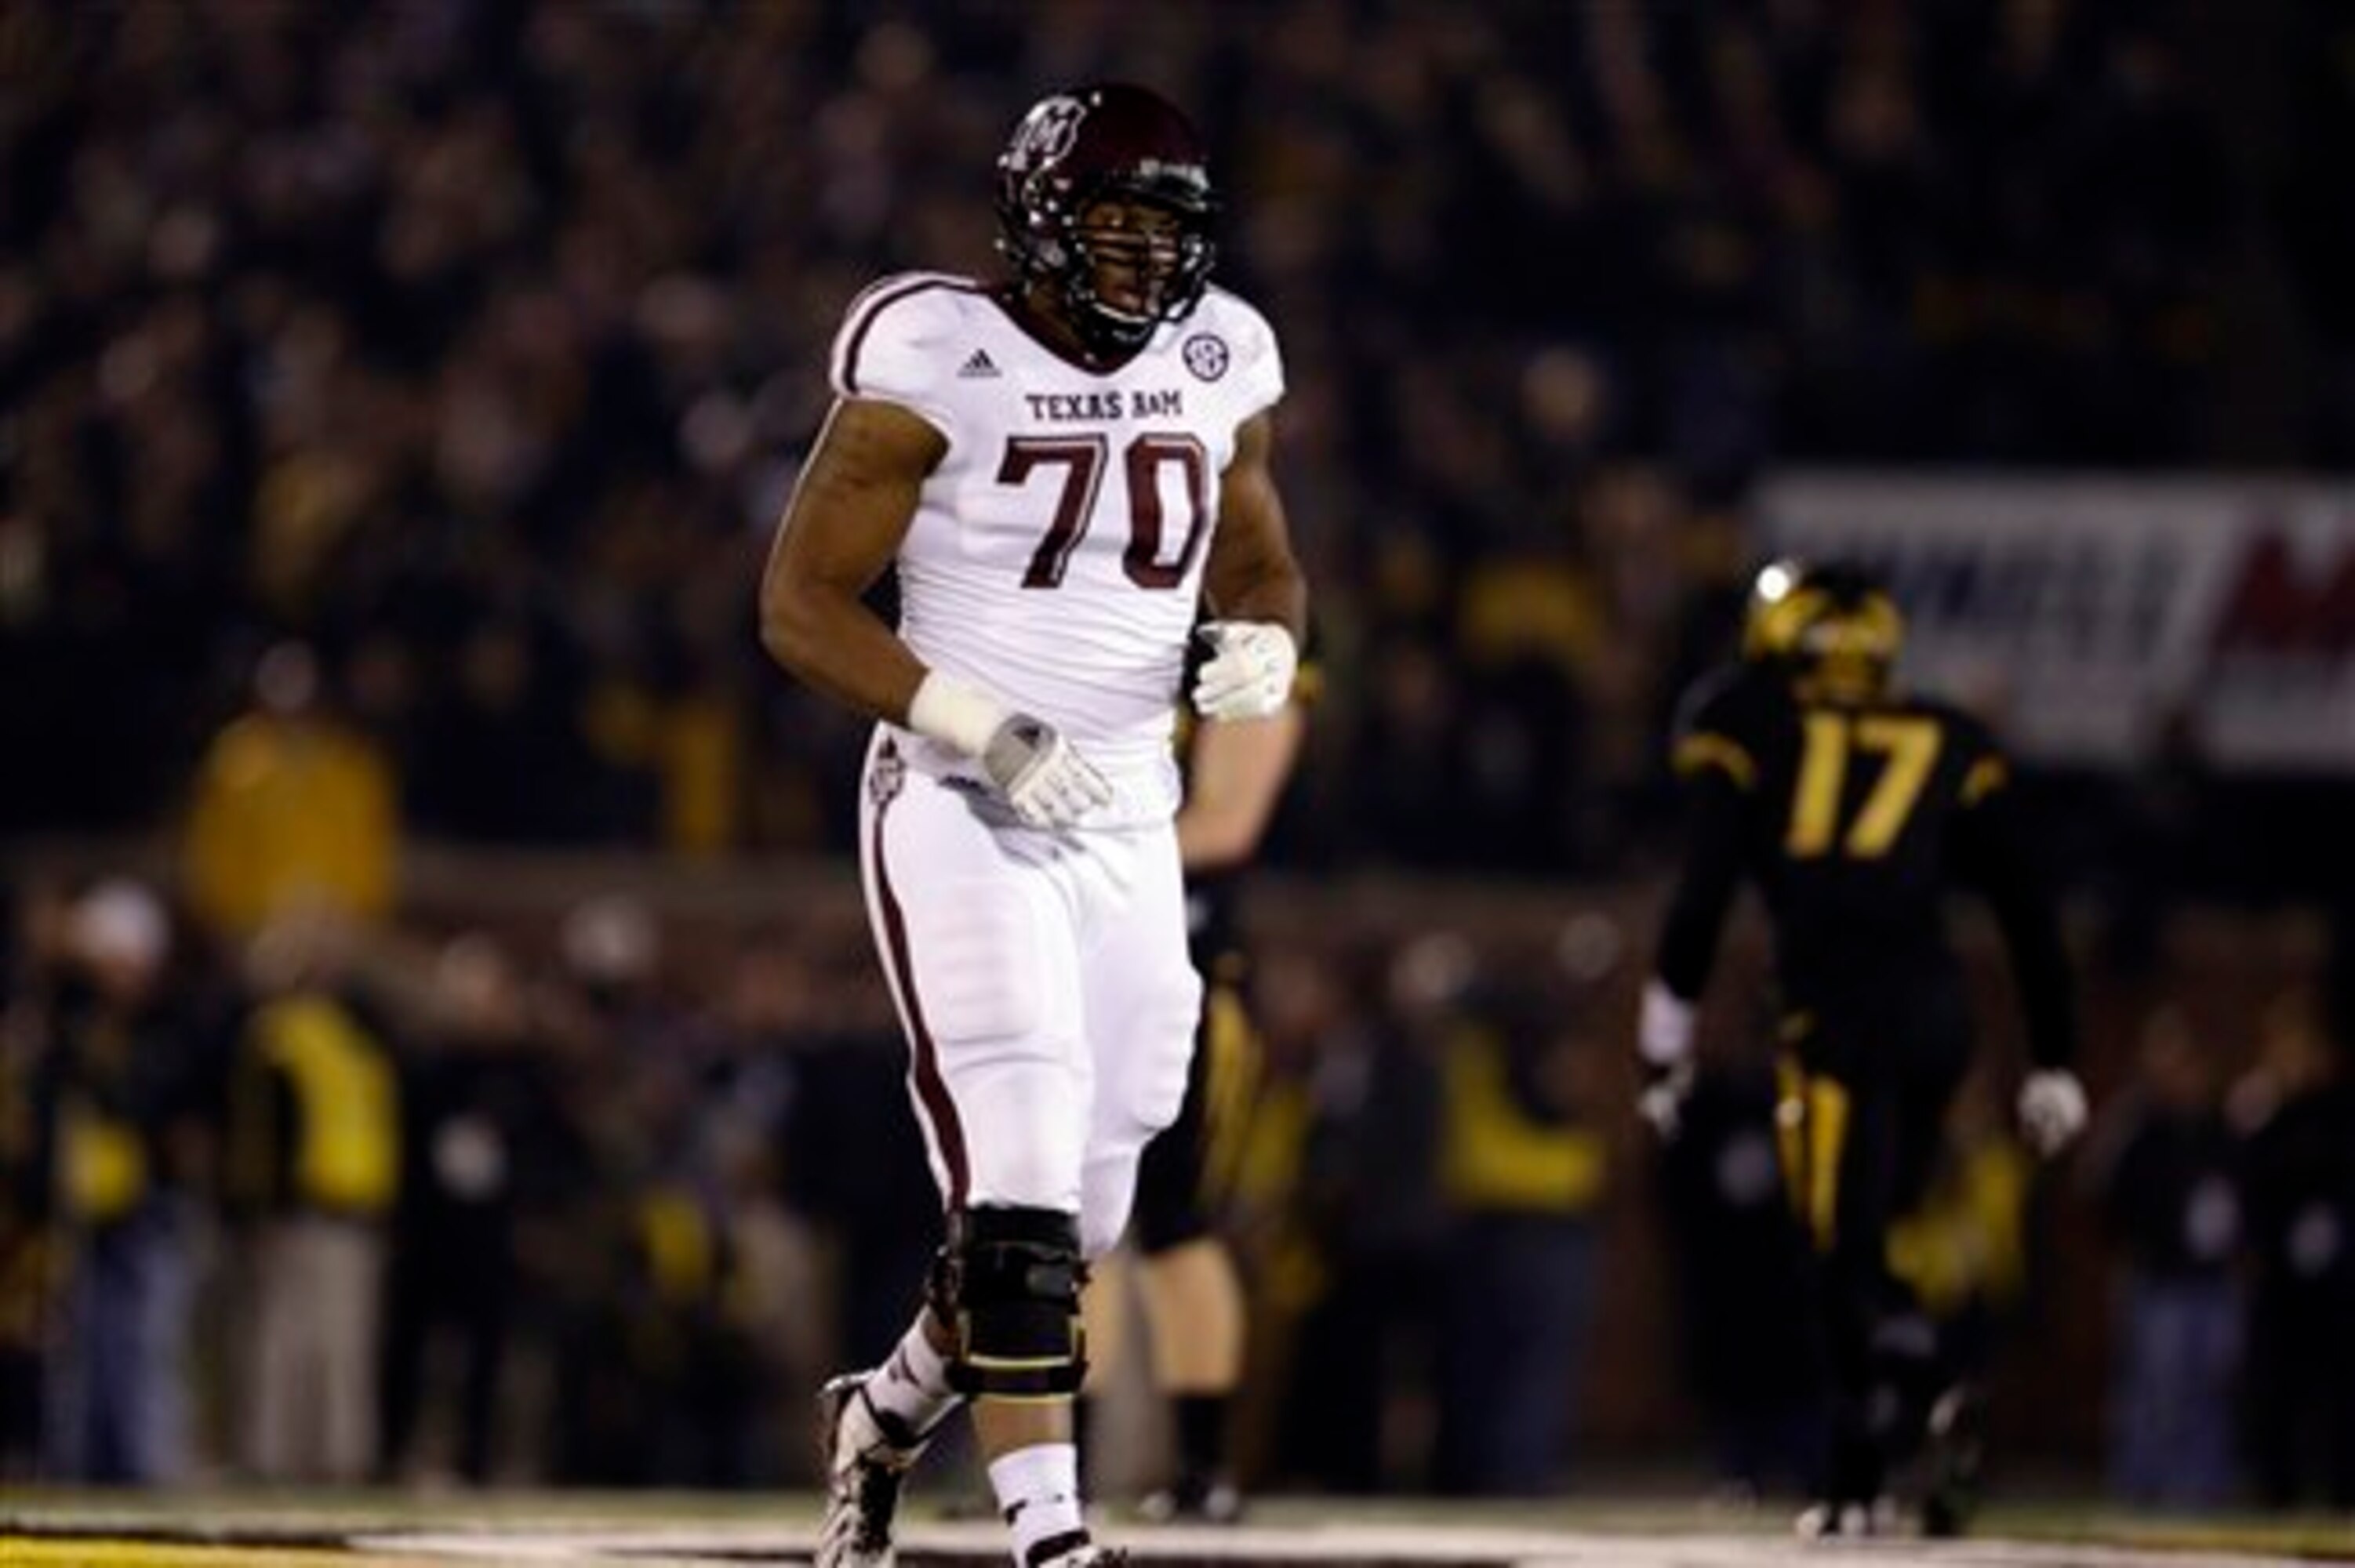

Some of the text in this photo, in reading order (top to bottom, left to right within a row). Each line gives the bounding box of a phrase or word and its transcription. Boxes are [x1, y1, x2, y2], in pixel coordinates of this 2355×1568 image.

[1024, 391, 1122, 421] TEXAS
[996, 432, 1208, 590] 70
[1788, 712, 1941, 856] 17
